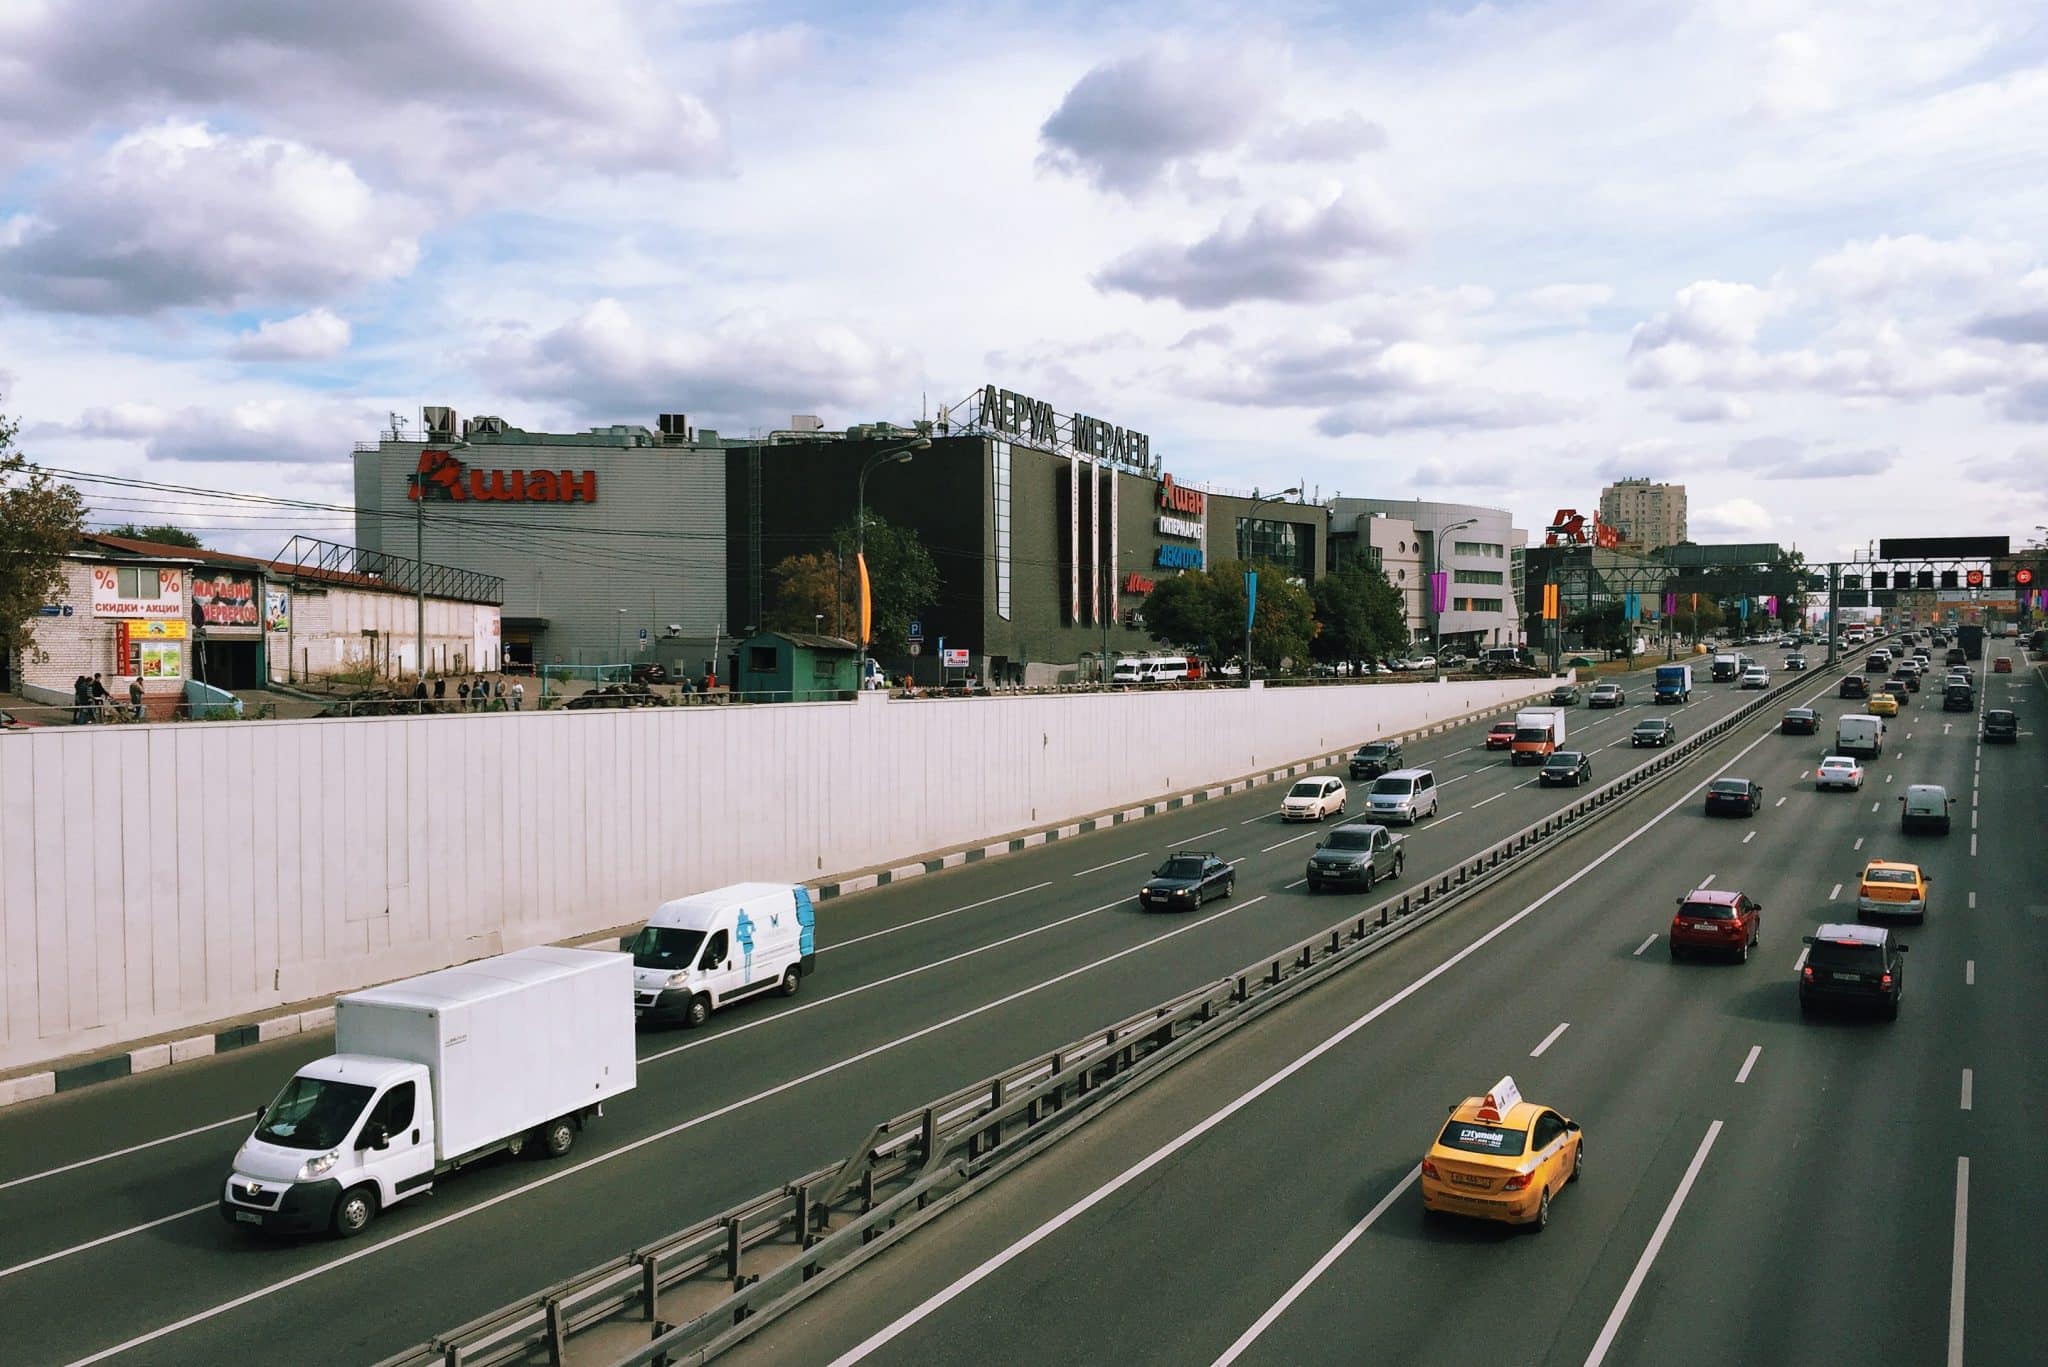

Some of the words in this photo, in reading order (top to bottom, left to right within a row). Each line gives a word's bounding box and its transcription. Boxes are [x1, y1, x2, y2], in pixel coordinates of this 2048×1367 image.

[981, 385, 1057, 445] ЛЕРУА
[1074, 413, 1149, 467] МЕРЛЕН
[407, 450, 596, 502] Ашан
[1161, 473, 1204, 514] Ашан
[1160, 516, 1204, 538] ГИПЕРМАРКЕТ
[192, 580, 251, 598] МАГАЗИН
[95, 603, 138, 613] СКИДКИ
[146, 604, 179, 613] АКЦИИ
[202, 603, 257, 622] ЙЕРВЕРКОВ
